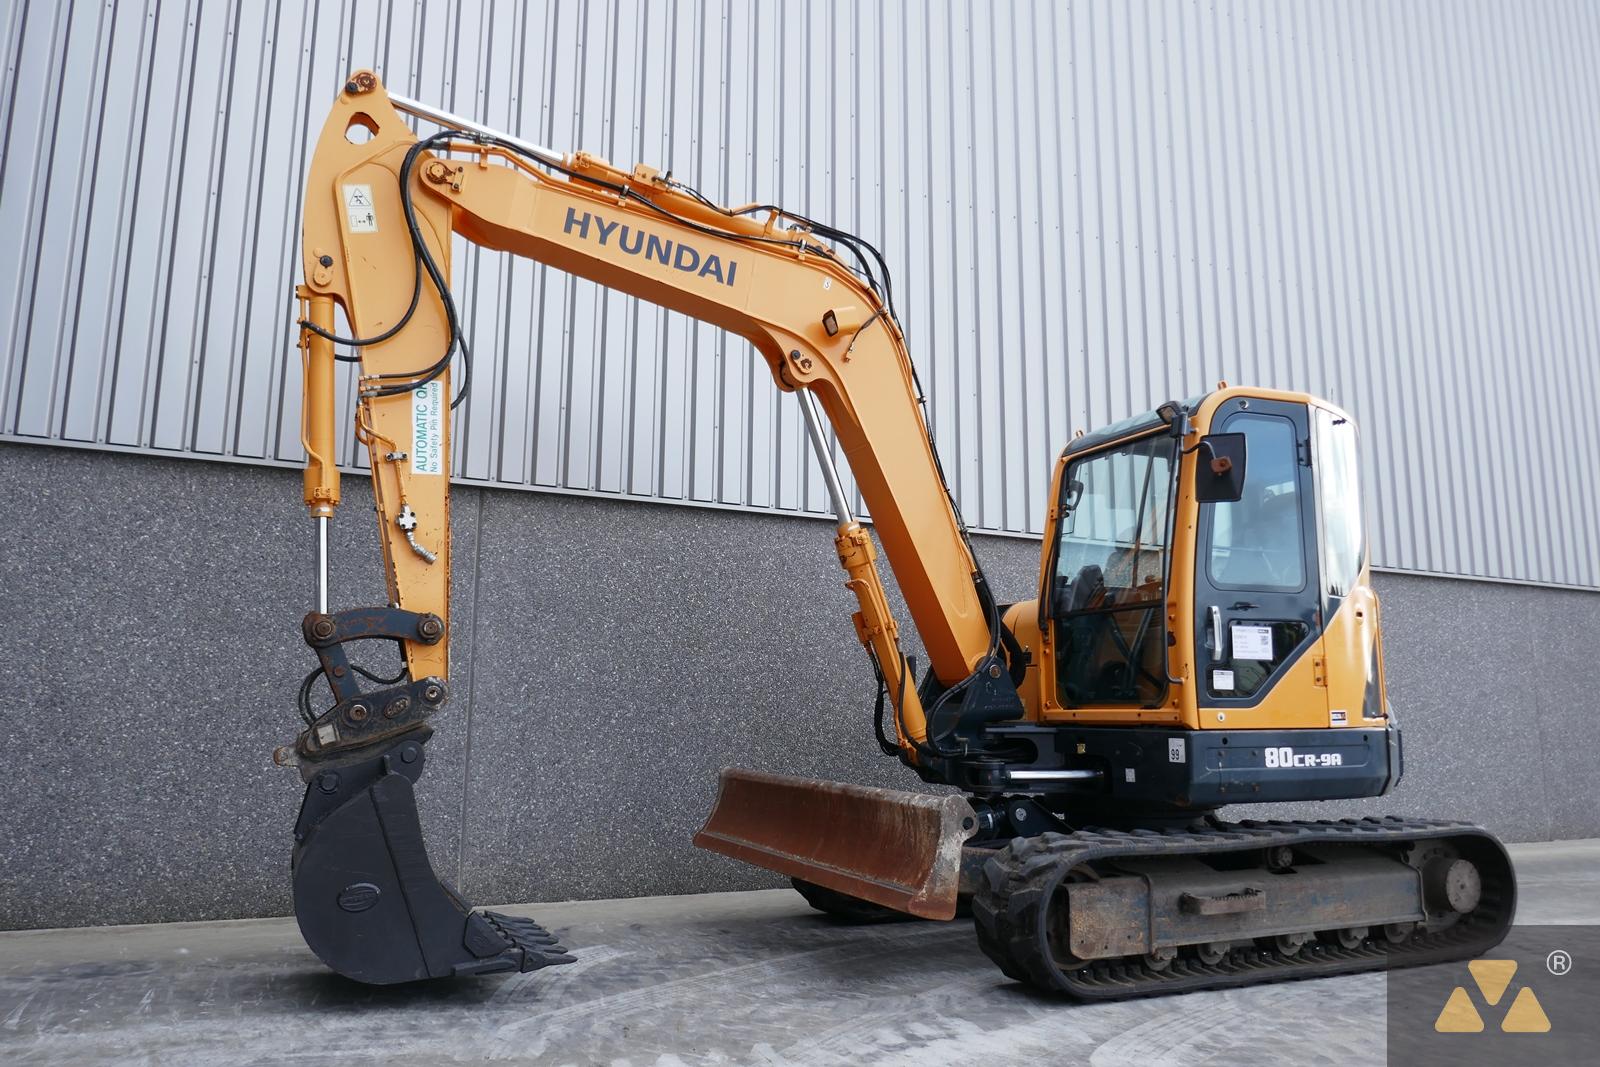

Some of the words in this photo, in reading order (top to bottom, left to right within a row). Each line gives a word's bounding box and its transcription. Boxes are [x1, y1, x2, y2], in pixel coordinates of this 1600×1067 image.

[564, 207, 737, 287] HYUNDAI
[430, 382, 439, 416] Required
[430, 419, 438, 431] Pin
[415, 404, 428, 472] AUTOMATIC
[430, 434, 439, 459] Safety
[430, 462, 438, 473] No
[1264, 747, 1342, 768] 80CR-9A
